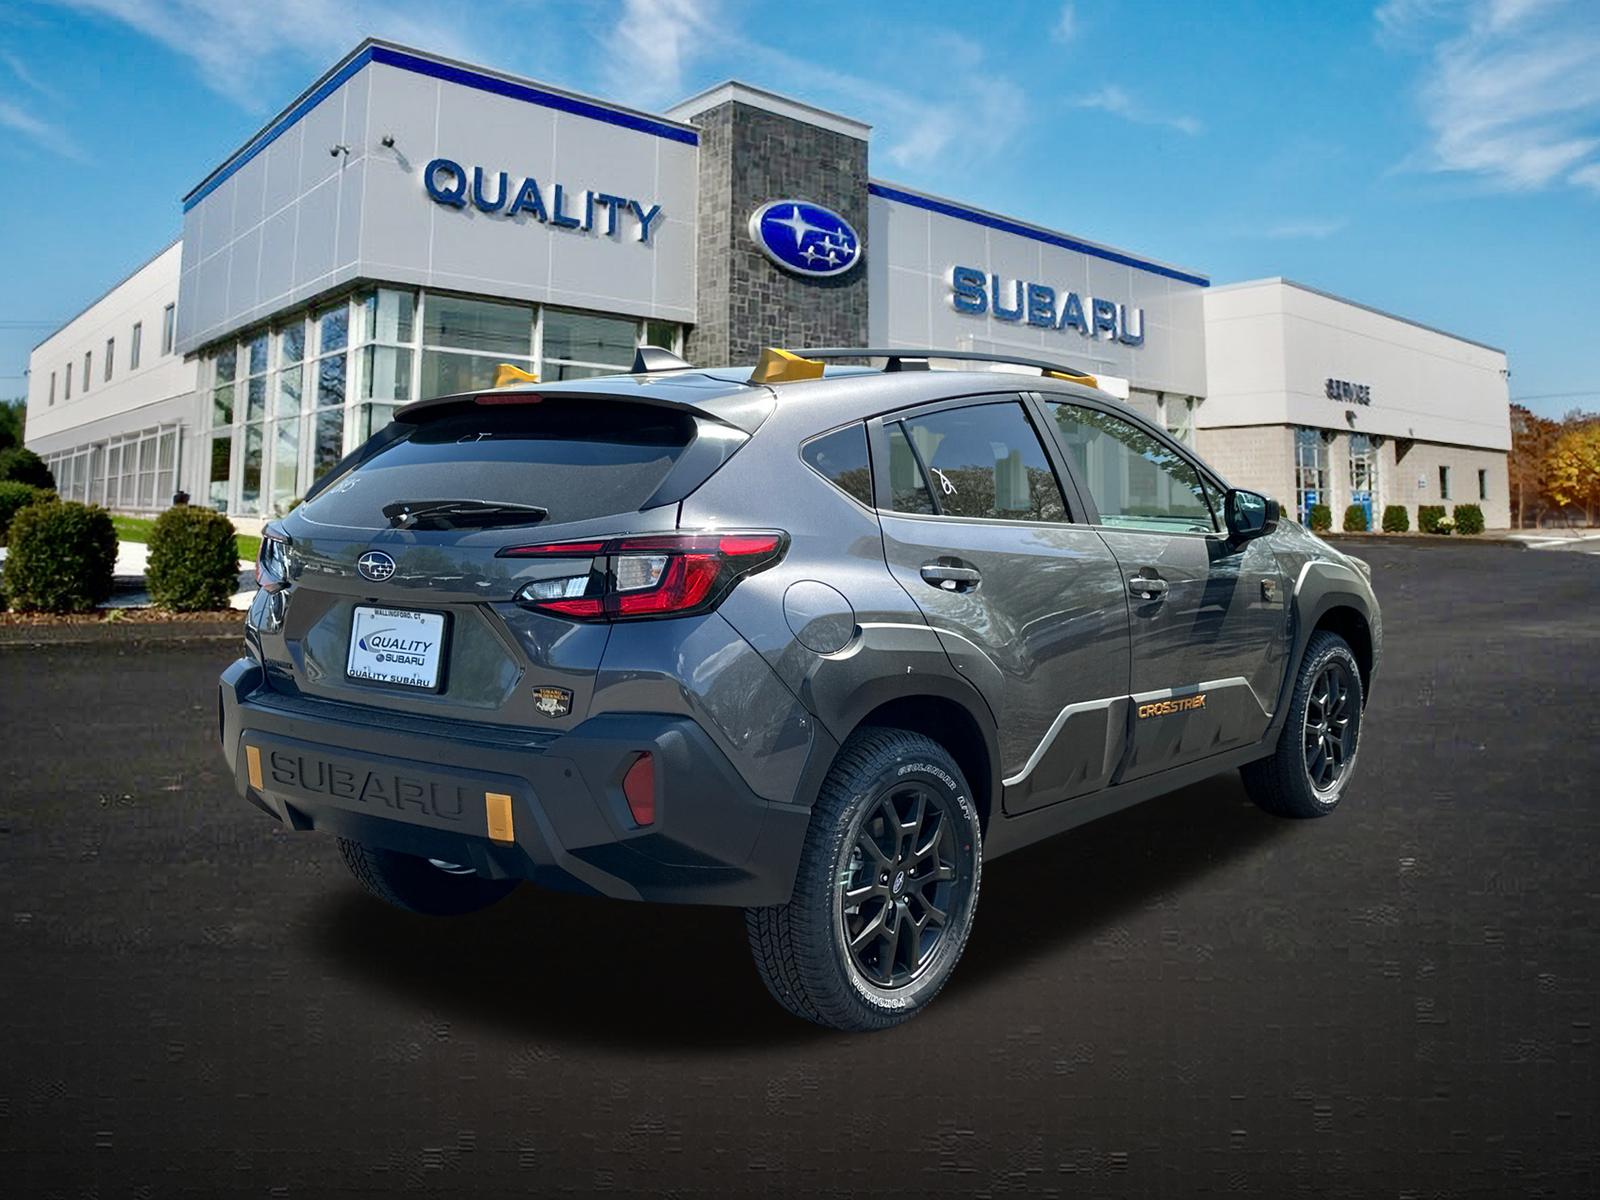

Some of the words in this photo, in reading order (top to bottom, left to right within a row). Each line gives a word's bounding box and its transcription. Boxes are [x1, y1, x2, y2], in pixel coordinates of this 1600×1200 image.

[424, 158, 662, 242] QUALITY
[951, 265, 1145, 346] SUBARU
[1324, 378, 1370, 406] SERVICE
[371, 636, 433, 653] QUALITY
[385, 653, 425, 666] SUBARU
[349, 669, 388, 681] QUALITY
[390, 675, 430, 687] SUBARU
[1138, 694, 1207, 719] CROSSTREK
[271, 751, 467, 822] SUBARU
[852, 975, 906, 1009] YOKOHAMA
